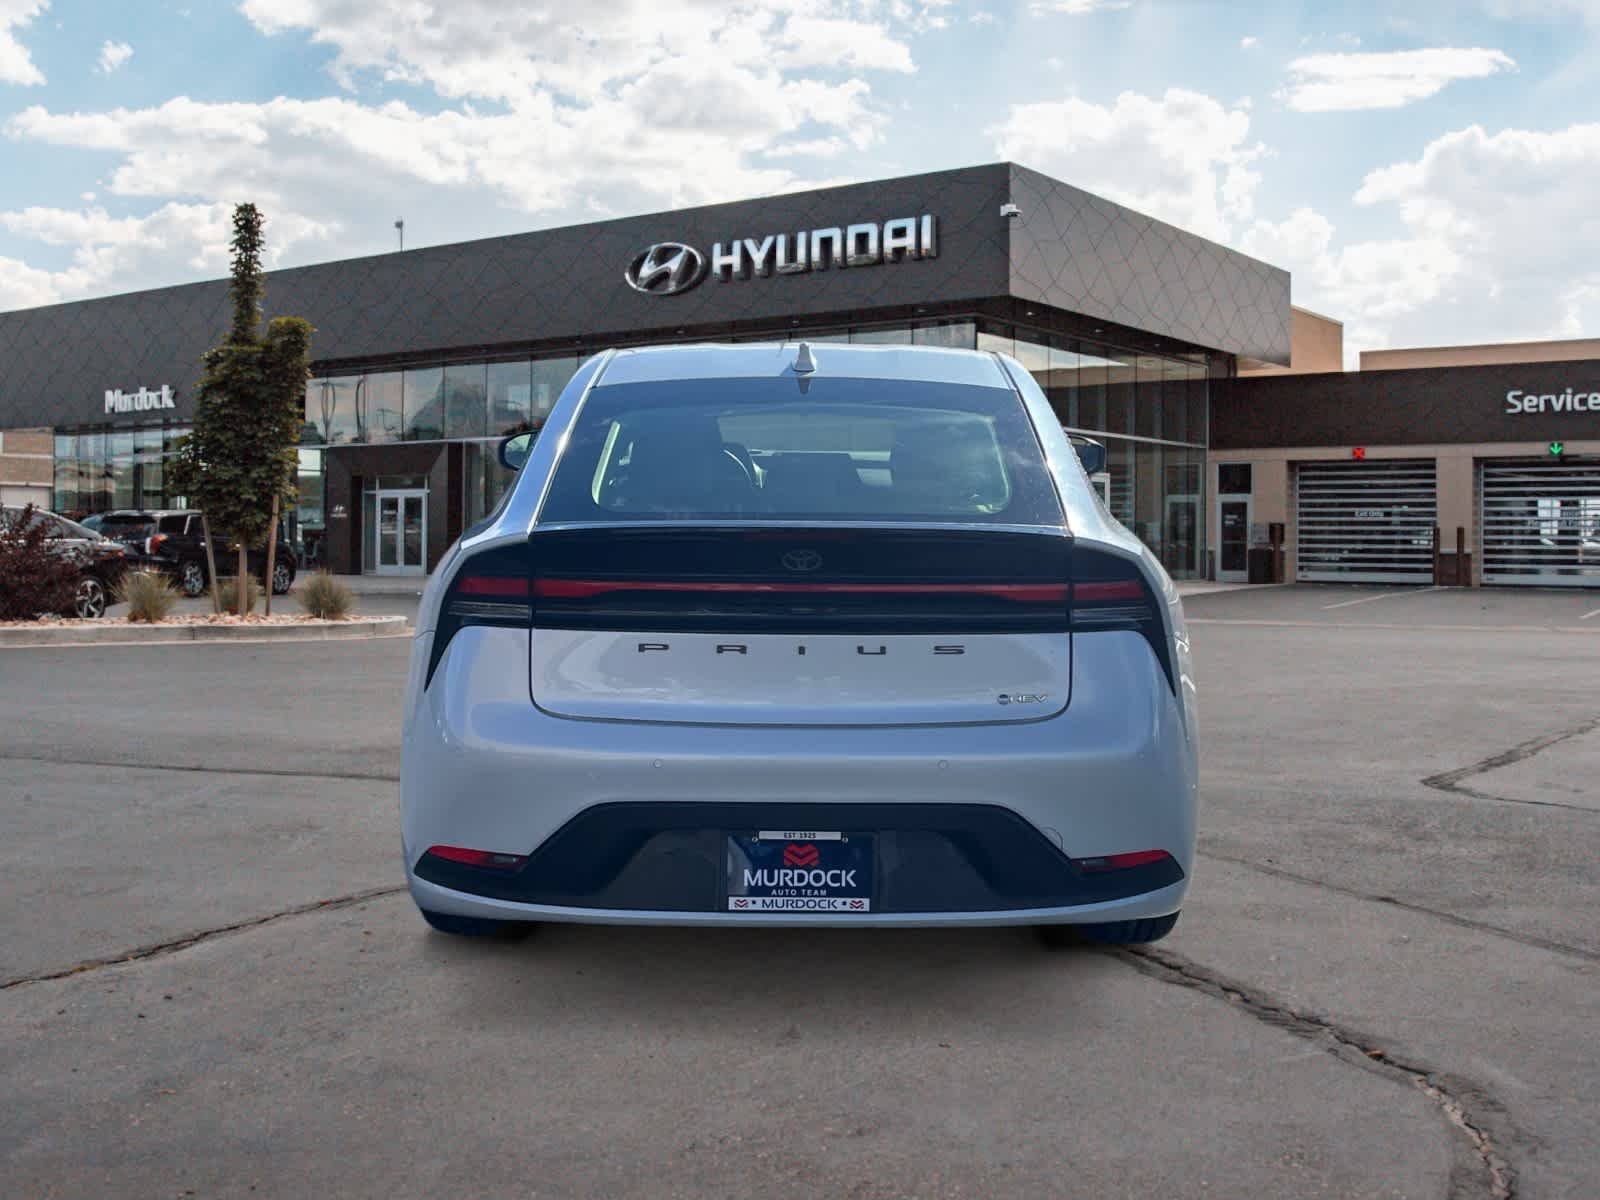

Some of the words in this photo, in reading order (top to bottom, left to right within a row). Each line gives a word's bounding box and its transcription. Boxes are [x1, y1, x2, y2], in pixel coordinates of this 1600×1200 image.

[711, 214, 938, 281] HYUNDAI
[104, 384, 176, 414] Murdock
[1505, 387, 1600, 414] Service
[638, 643, 965, 655] PRIUS
[743, 868, 857, 887] MURDOCK
[771, 888, 797, 896] AUTO
[802, 888, 827, 896] TEAM
[761, 899, 838, 910] MURDOCK
